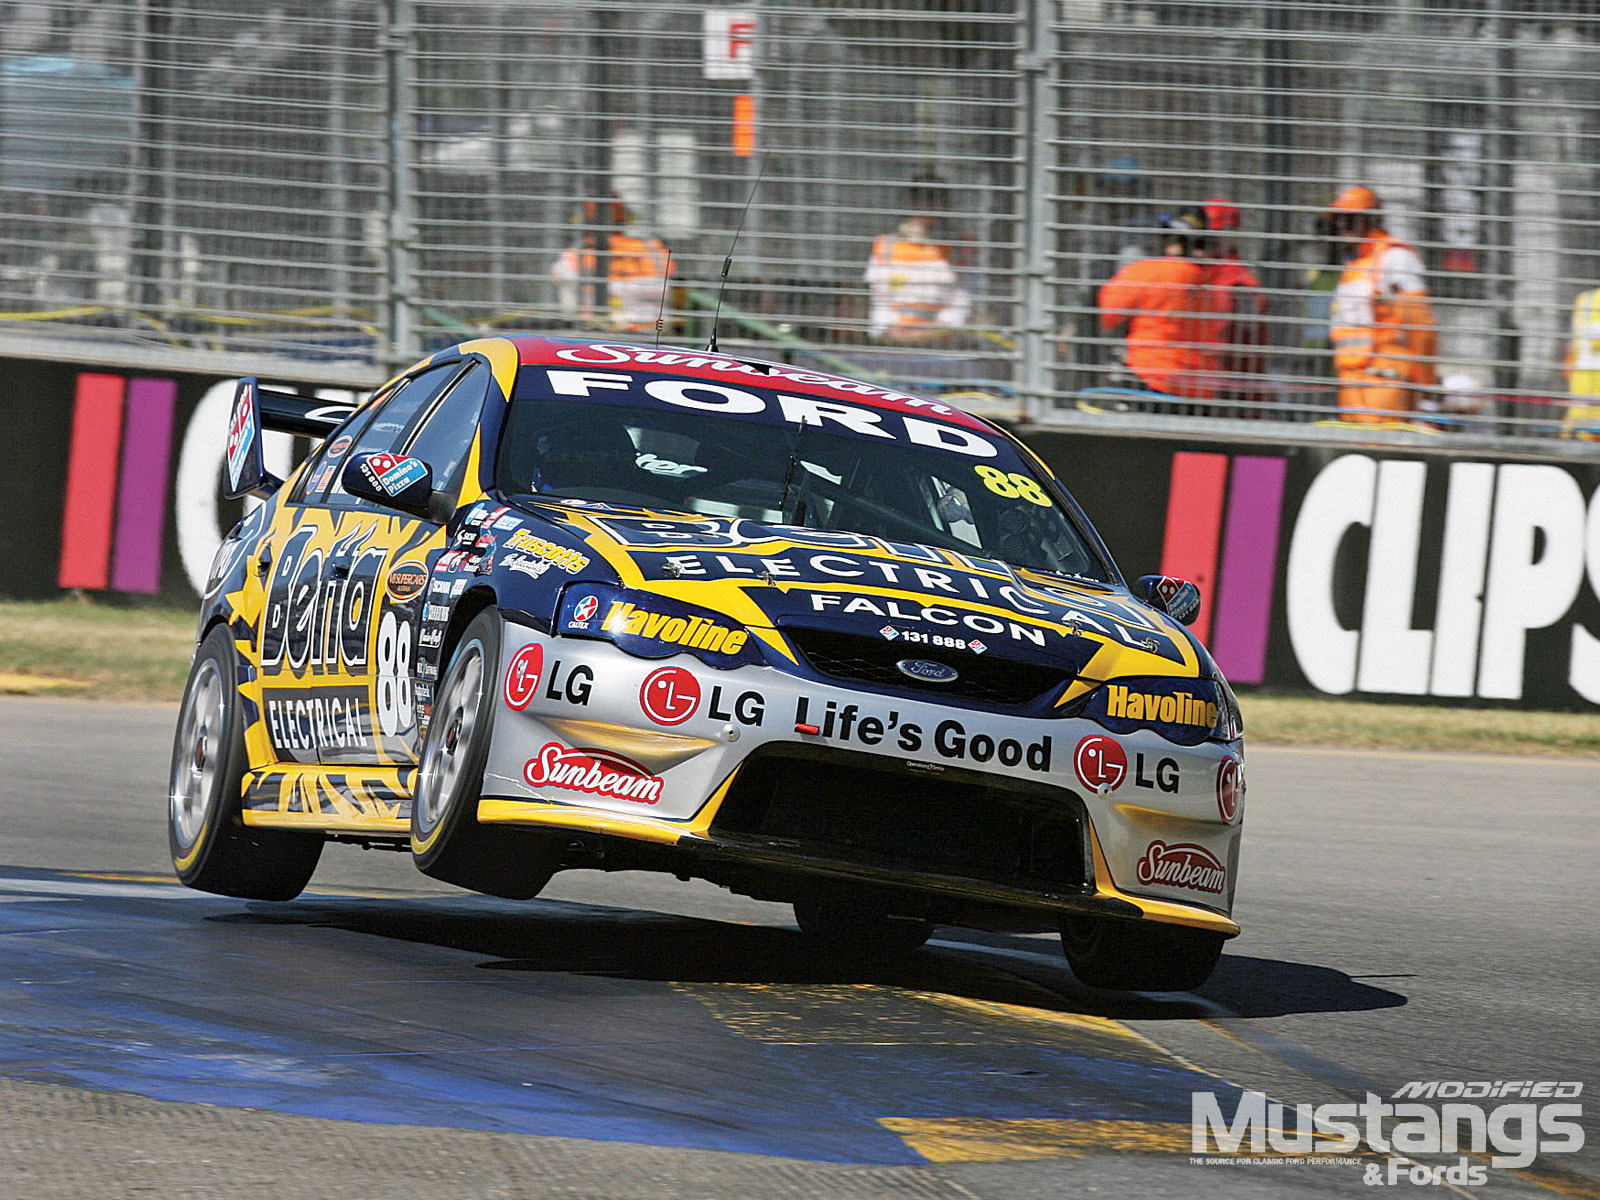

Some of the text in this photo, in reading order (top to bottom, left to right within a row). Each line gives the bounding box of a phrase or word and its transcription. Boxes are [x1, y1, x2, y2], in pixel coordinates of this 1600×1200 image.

[729, 22, 757, 59] F
[546, 370, 998, 458] FORD
[360, 463, 372, 477] 131
[382, 460, 418, 486] Domino's
[387, 476, 411, 494] Pizza
[974, 464, 1053, 508] 88
[666, 554, 1154, 651] ELECTRICAL
[811, 593, 1046, 647] FALCON
[600, 600, 748, 655] Havoline
[902, 631, 928, 644] 131
[932, 635, 966, 649] 888
[377, 611, 412, 737] 88
[546, 660, 594, 706] LG
[910, 661, 946, 679] Ford
[268, 697, 368, 749] ELECTRICAL
[708, 686, 765, 727] LG
[1106, 684, 1218, 728] Havoline
[794, 696, 1052, 772] Life's Good
[526, 746, 661, 802] Sunbeam
[1135, 753, 1180, 794] LG
[1138, 844, 1226, 891] Sunbeam
